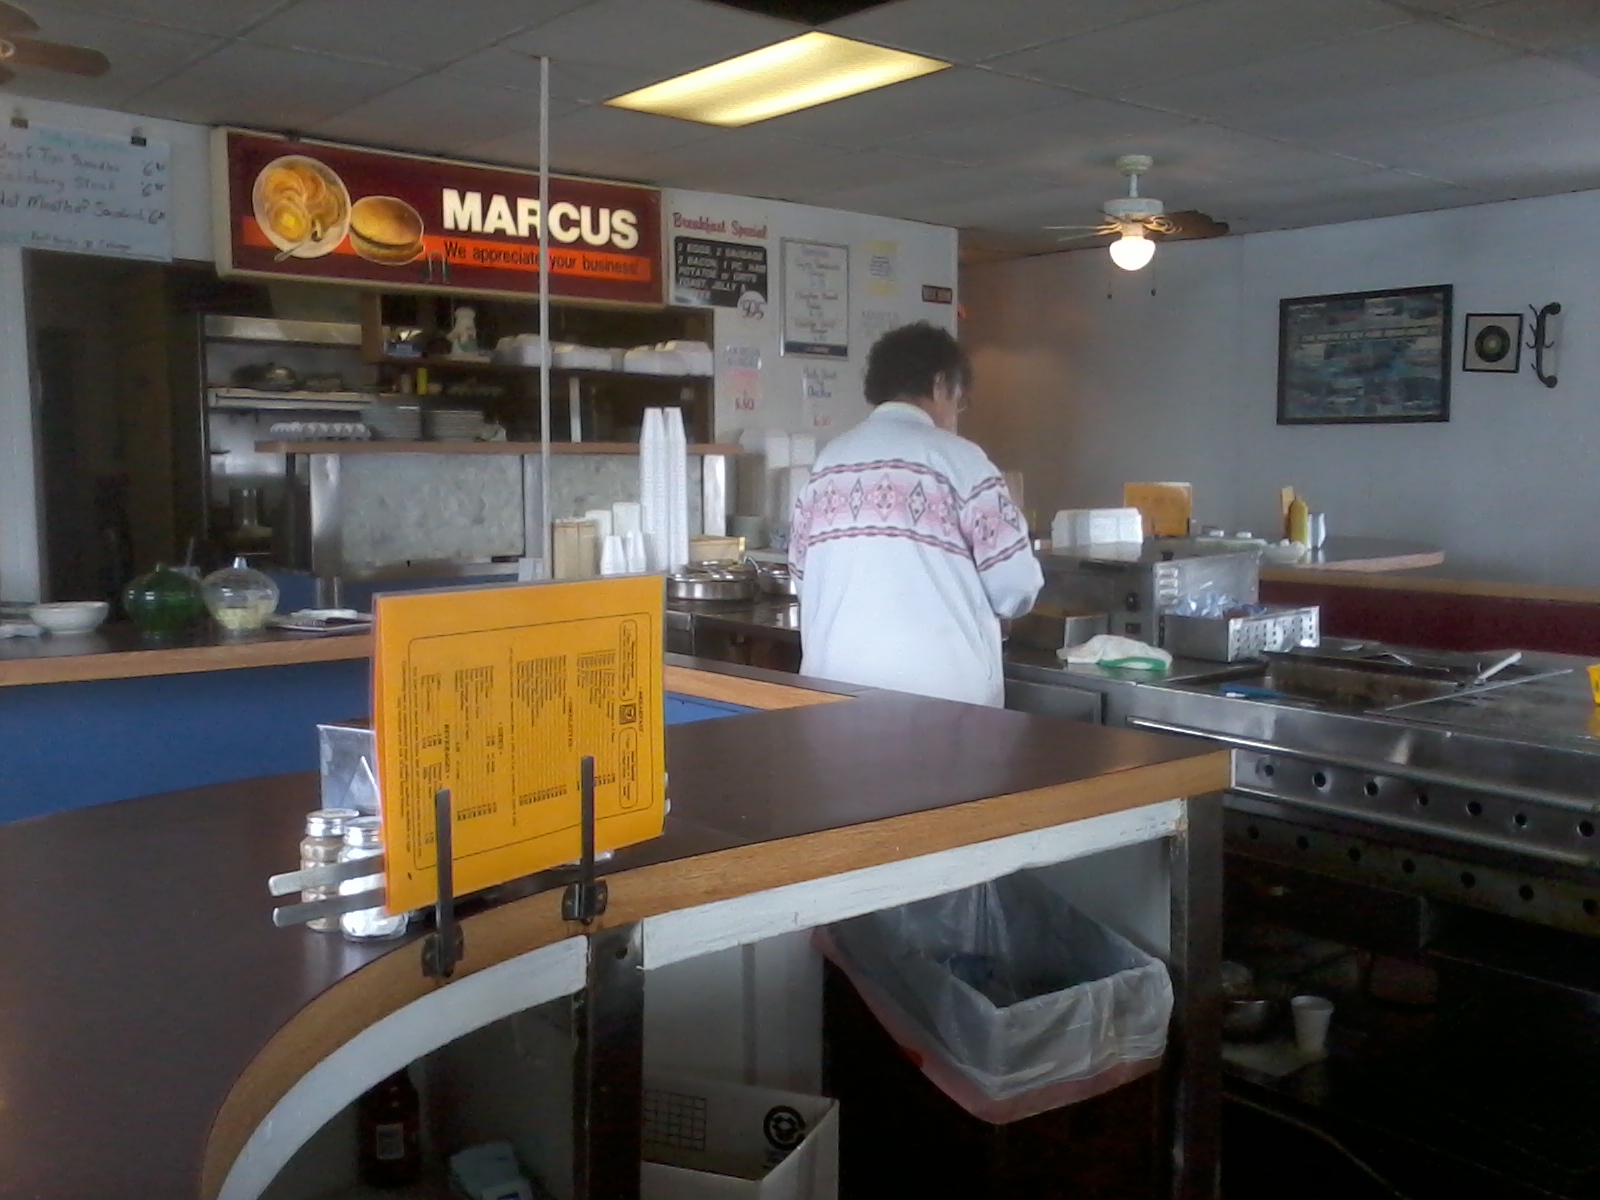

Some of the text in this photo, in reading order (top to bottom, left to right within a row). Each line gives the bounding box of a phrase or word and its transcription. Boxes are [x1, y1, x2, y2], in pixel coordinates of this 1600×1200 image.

[442, 188, 640, 250] MARCUS
[673, 212, 769, 240] Breakfast Special
[444, 240, 466, 259] We
[549, 255, 576, 270] your
